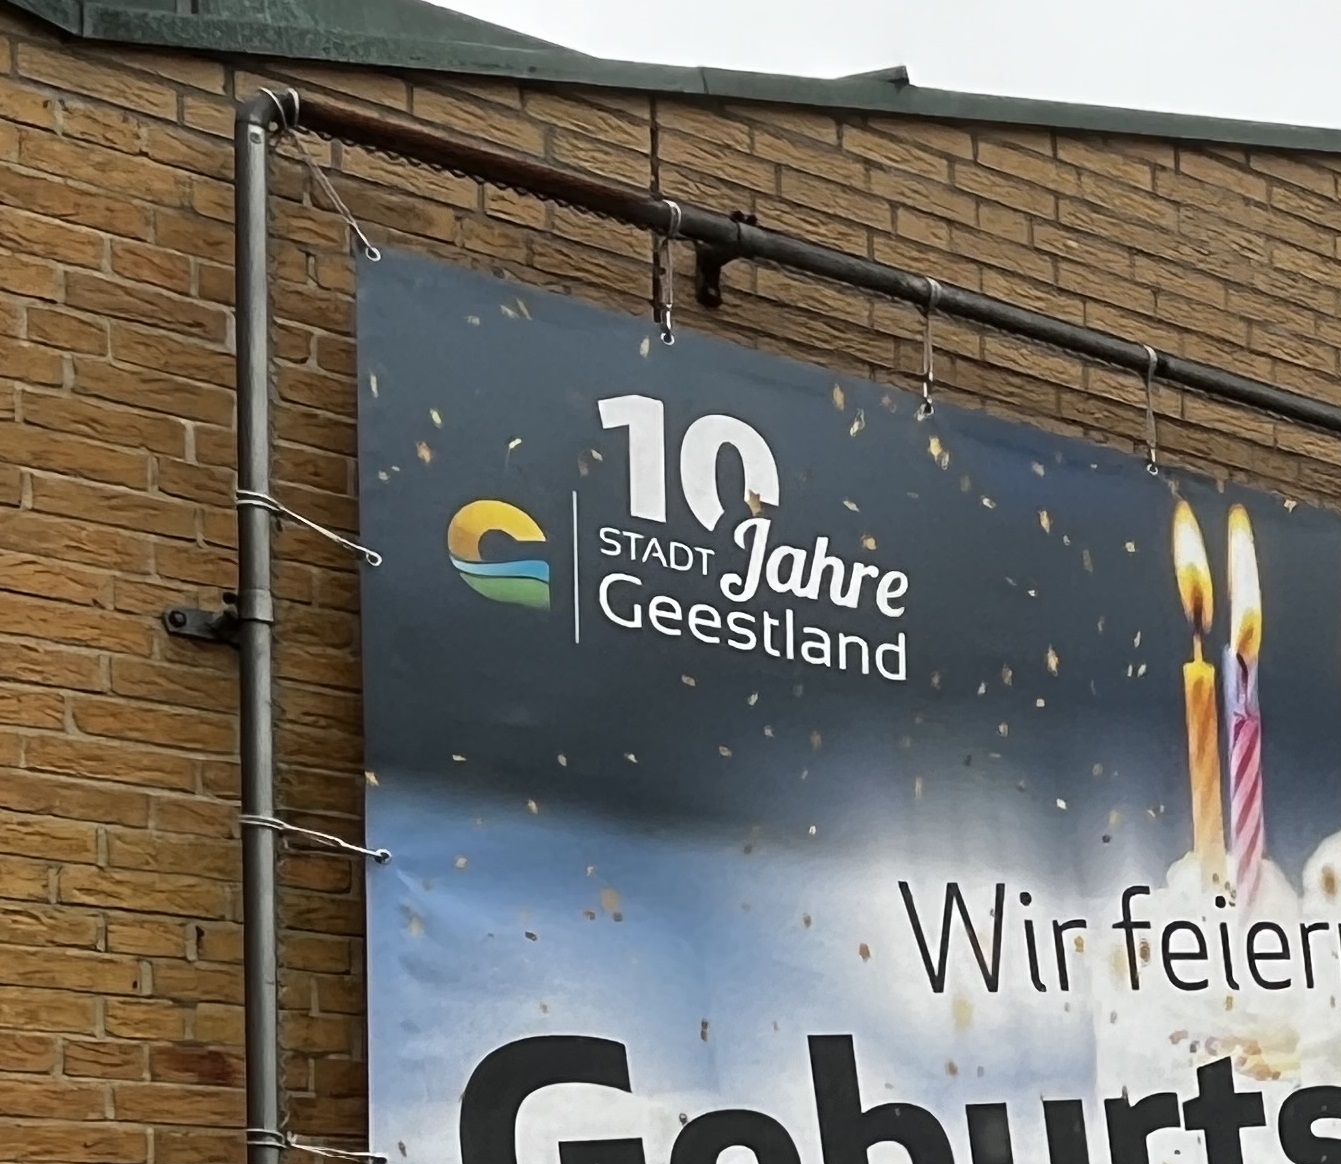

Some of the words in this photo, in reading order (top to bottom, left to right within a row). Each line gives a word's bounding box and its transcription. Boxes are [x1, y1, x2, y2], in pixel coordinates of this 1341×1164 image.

[597, 395, 780, 531] 10
[600, 528, 715, 575] STADT
[720, 518, 908, 618] Jahre
[599, 573, 907, 681] Geestland
[898, 881, 1087, 993] Wir
